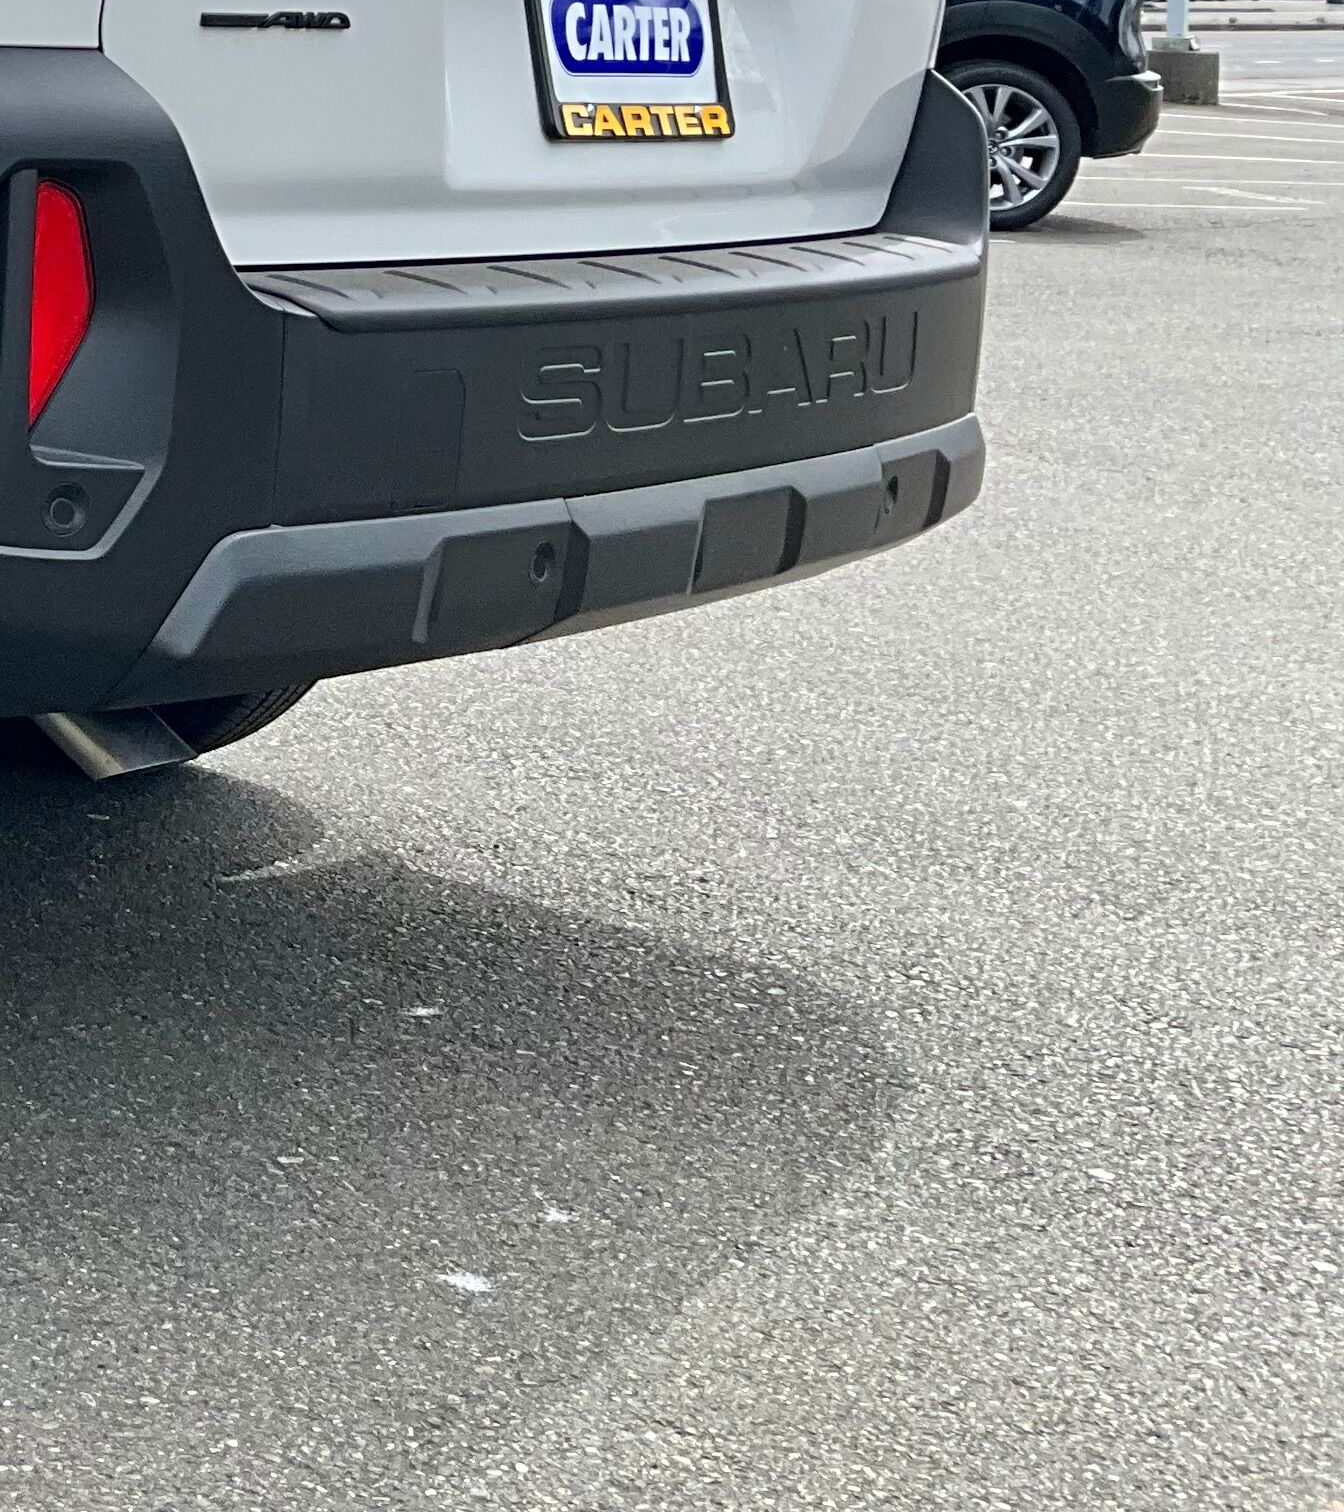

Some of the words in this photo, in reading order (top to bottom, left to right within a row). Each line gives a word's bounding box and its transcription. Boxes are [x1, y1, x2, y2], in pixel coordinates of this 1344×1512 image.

[259, 12, 351, 29] AWD
[564, 1, 691, 63] CARTER
[562, 103, 732, 138] CARTER
[518, 310, 918, 441] SUBARU
